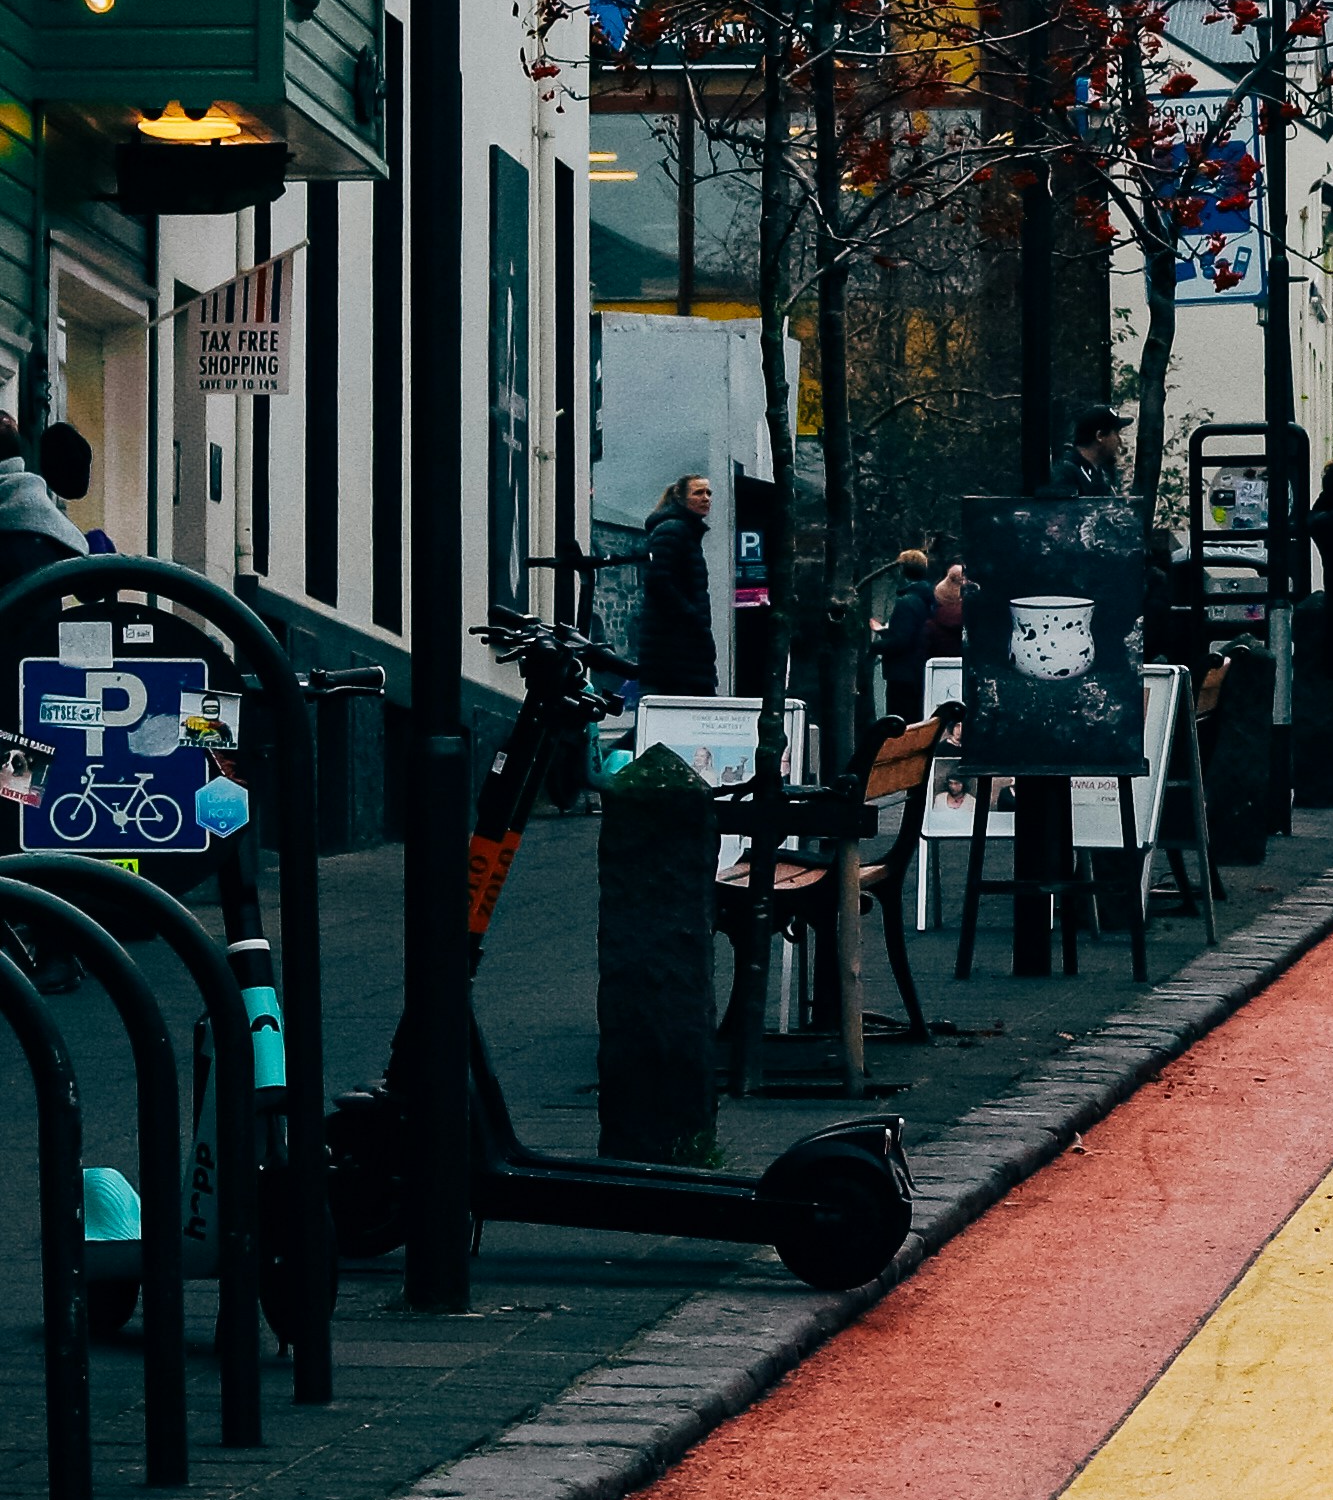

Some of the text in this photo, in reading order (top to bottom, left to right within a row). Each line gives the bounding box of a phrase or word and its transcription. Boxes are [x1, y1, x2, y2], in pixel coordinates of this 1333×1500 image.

[200, 330, 279, 352] TAX FREE
[199, 355, 279, 376] SHOPPING
[199, 379, 277, 390] SAVE UP TO 14%
[741, 532, 760, 557] P
[86, 672, 148, 756] P
[1071, 780, 1095, 790] NNA
